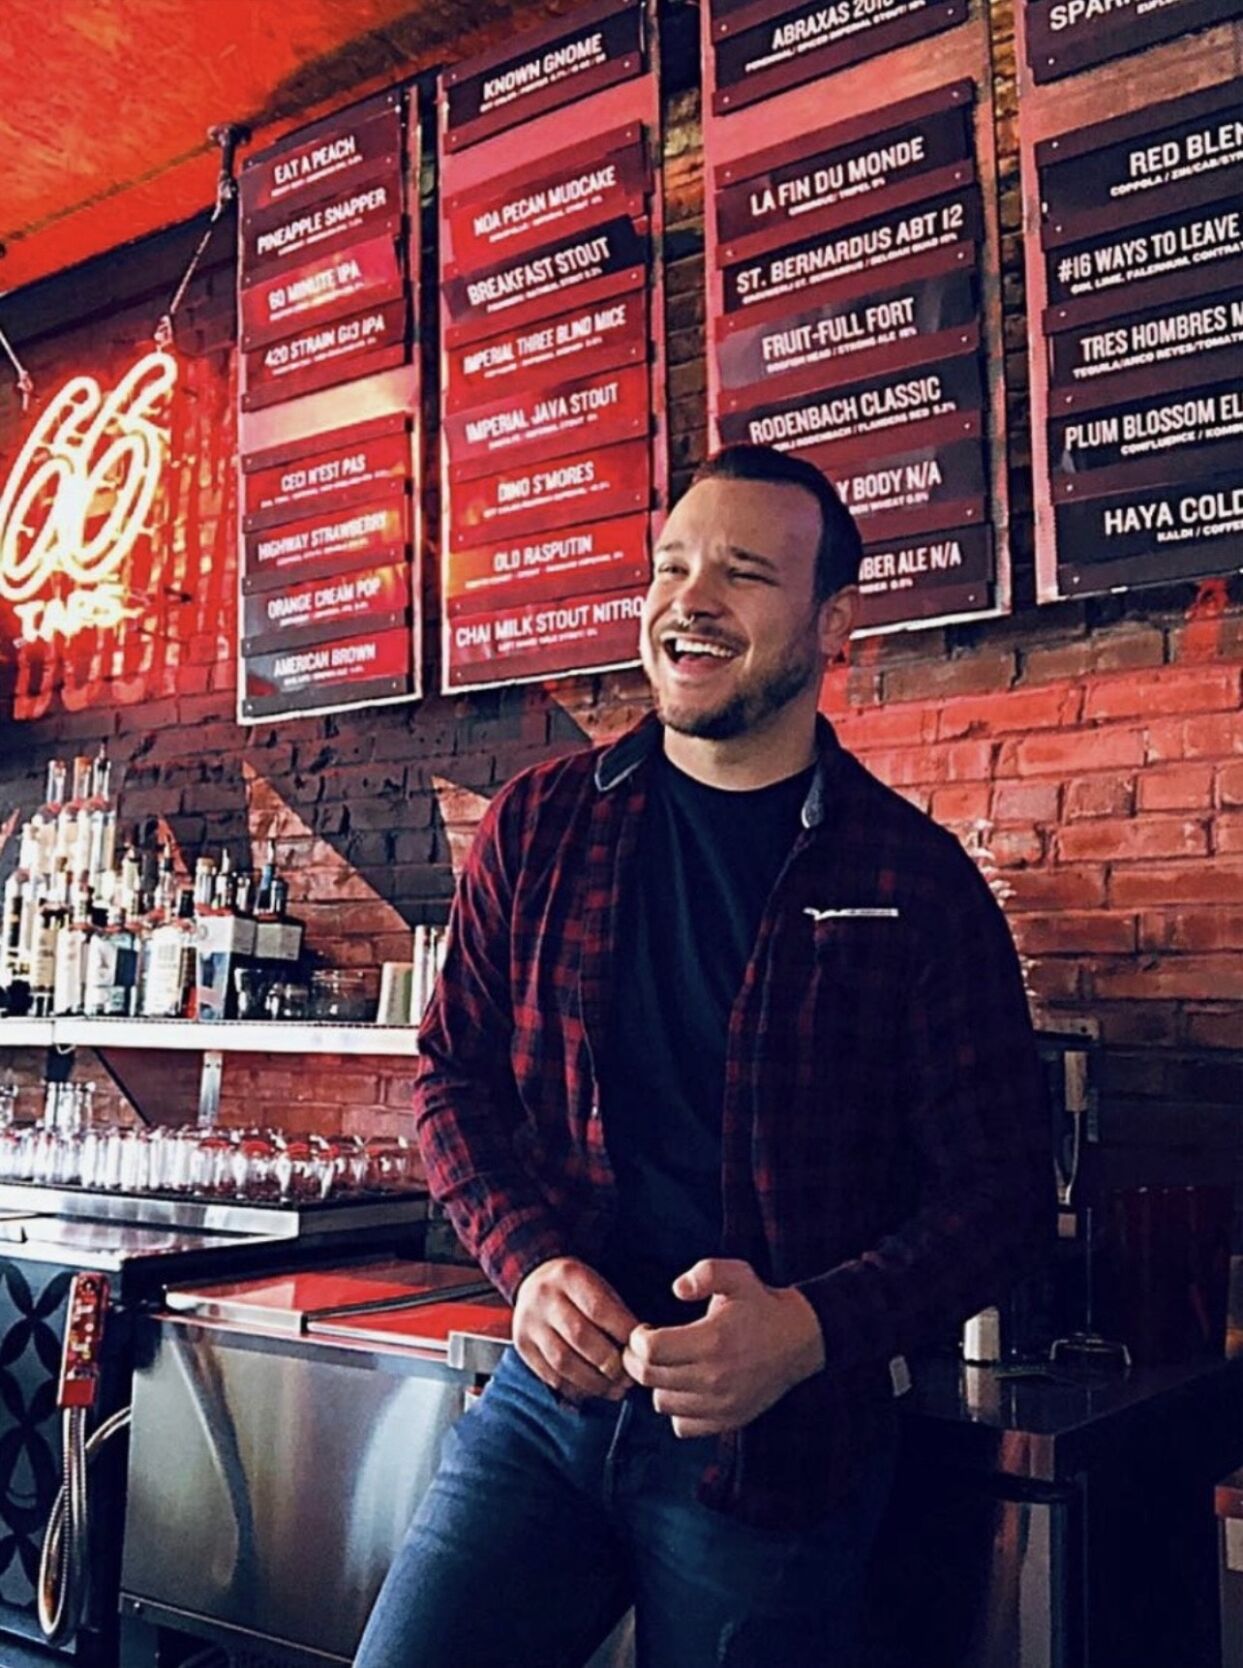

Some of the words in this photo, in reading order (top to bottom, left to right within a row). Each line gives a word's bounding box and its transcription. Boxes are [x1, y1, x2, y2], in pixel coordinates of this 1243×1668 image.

[772, 2, 850, 50] ABRAXAS
[483, 60, 540, 101] KNOWN
[543, 33, 602, 74] GNOME
[274, 159, 299, 185] EAT
[302, 156, 312, 173] A
[311, 136, 356, 169] PEACH
[751, 188, 776, 216] LA
[778, 175, 811, 207] FIN
[814, 163, 844, 194] DU
[848, 136, 925, 183] MONDE
[1129, 141, 1180, 178] RED
[257, 213, 323, 255] PINEAPPLE
[325, 187, 386, 226] SNAPPER
[501, 192, 547, 225] PECAN
[548, 165, 617, 208] MUDCAKE
[337, 259, 362, 284] IPA
[466, 257, 554, 307] BREAKFAST
[554, 237, 611, 275] STOUT
[736, 267, 767, 294] ST.
[770, 226, 892, 284] BERNARDUS
[896, 211, 938, 245] ABT
[941, 204, 964, 232] 12
[1058, 252, 1092, 284] #16
[1095, 238, 1148, 273] WAYS
[1151, 230, 1176, 259] TO
[1180, 213, 1240, 251] LEAVE
[264, 345, 289, 368] 420
[290, 329, 336, 360] STRAIN
[362, 314, 385, 336] IPA
[463, 343, 515, 375] IMPERIAL
[517, 329, 555, 356] THREE
[556, 316, 592, 346] BLIND
[594, 304, 627, 332] MICE
[762, 313, 864, 361] FRUIT-FULL
[866, 297, 914, 332] FORT
[1080, 329, 1128, 363] TRES
[1132, 307, 1228, 350] HOMBRES
[465, 409, 530, 445] IMPERIAL
[530, 396, 569, 425] JAVA
[570, 382, 619, 414] STOUT
[749, 397, 859, 446] RODENBACH
[860, 376, 942, 417] CLASSIC
[1065, 417, 1118, 452] PLUM
[1122, 398, 1216, 442] BLOSSOM
[341, 453, 366, 474] PAS
[532, 461, 595, 495] S'MORES
[853, 467, 902, 502] BODY
[906, 460, 942, 490] N/A
[1104, 502, 1174, 535] HAYA
[494, 549, 520, 572] OLD
[523, 534, 593, 566] RASPUTIN
[898, 547, 928, 575] ALE
[931, 541, 962, 570] N/A
[314, 583, 355, 609] CREAM
[356, 576, 382, 599] POP
[455, 623, 491, 648] CHAI
[494, 614, 533, 641] MILK
[535, 604, 591, 633] STOUT
[592, 596, 645, 624] NITRO
[274, 650, 331, 677] AMERICAN
[331, 643, 377, 668] BROWN
